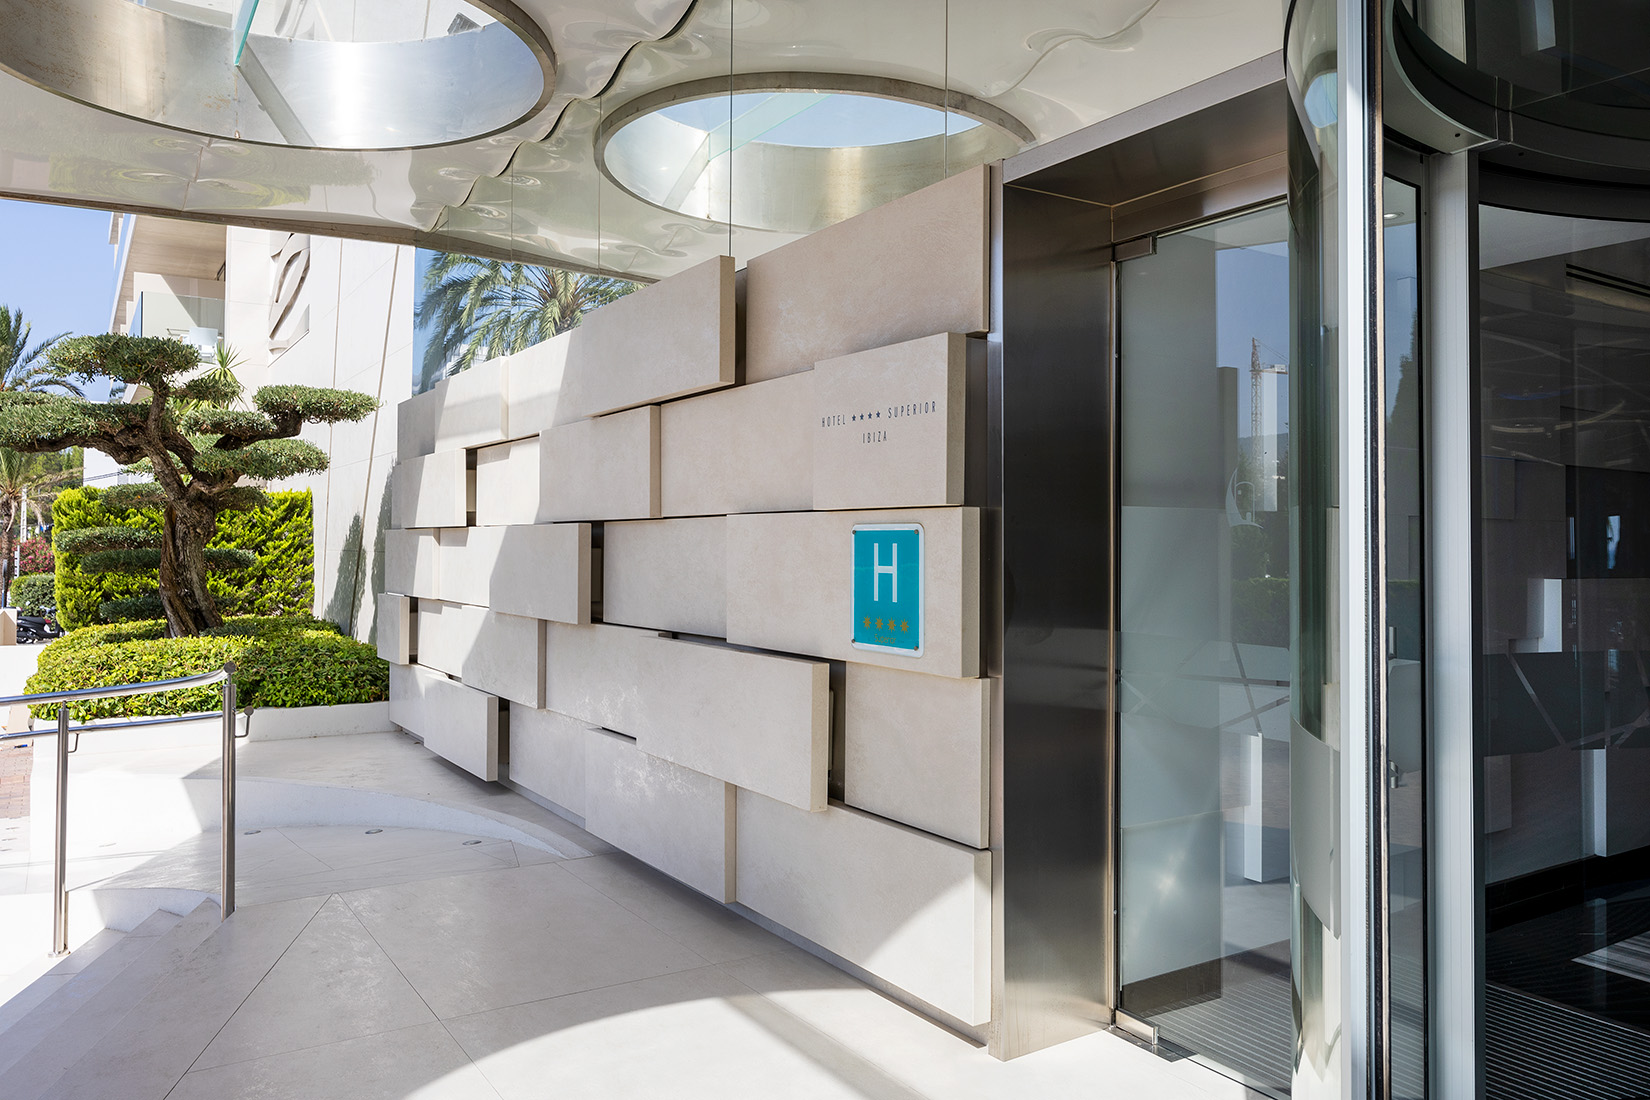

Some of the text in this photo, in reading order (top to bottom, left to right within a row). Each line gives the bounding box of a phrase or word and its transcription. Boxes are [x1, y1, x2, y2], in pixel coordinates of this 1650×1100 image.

[821, 401, 936, 428] HOTEL SUPERIOR
[862, 430, 888, 444] IBIZA
[873, 542, 898, 603] H
